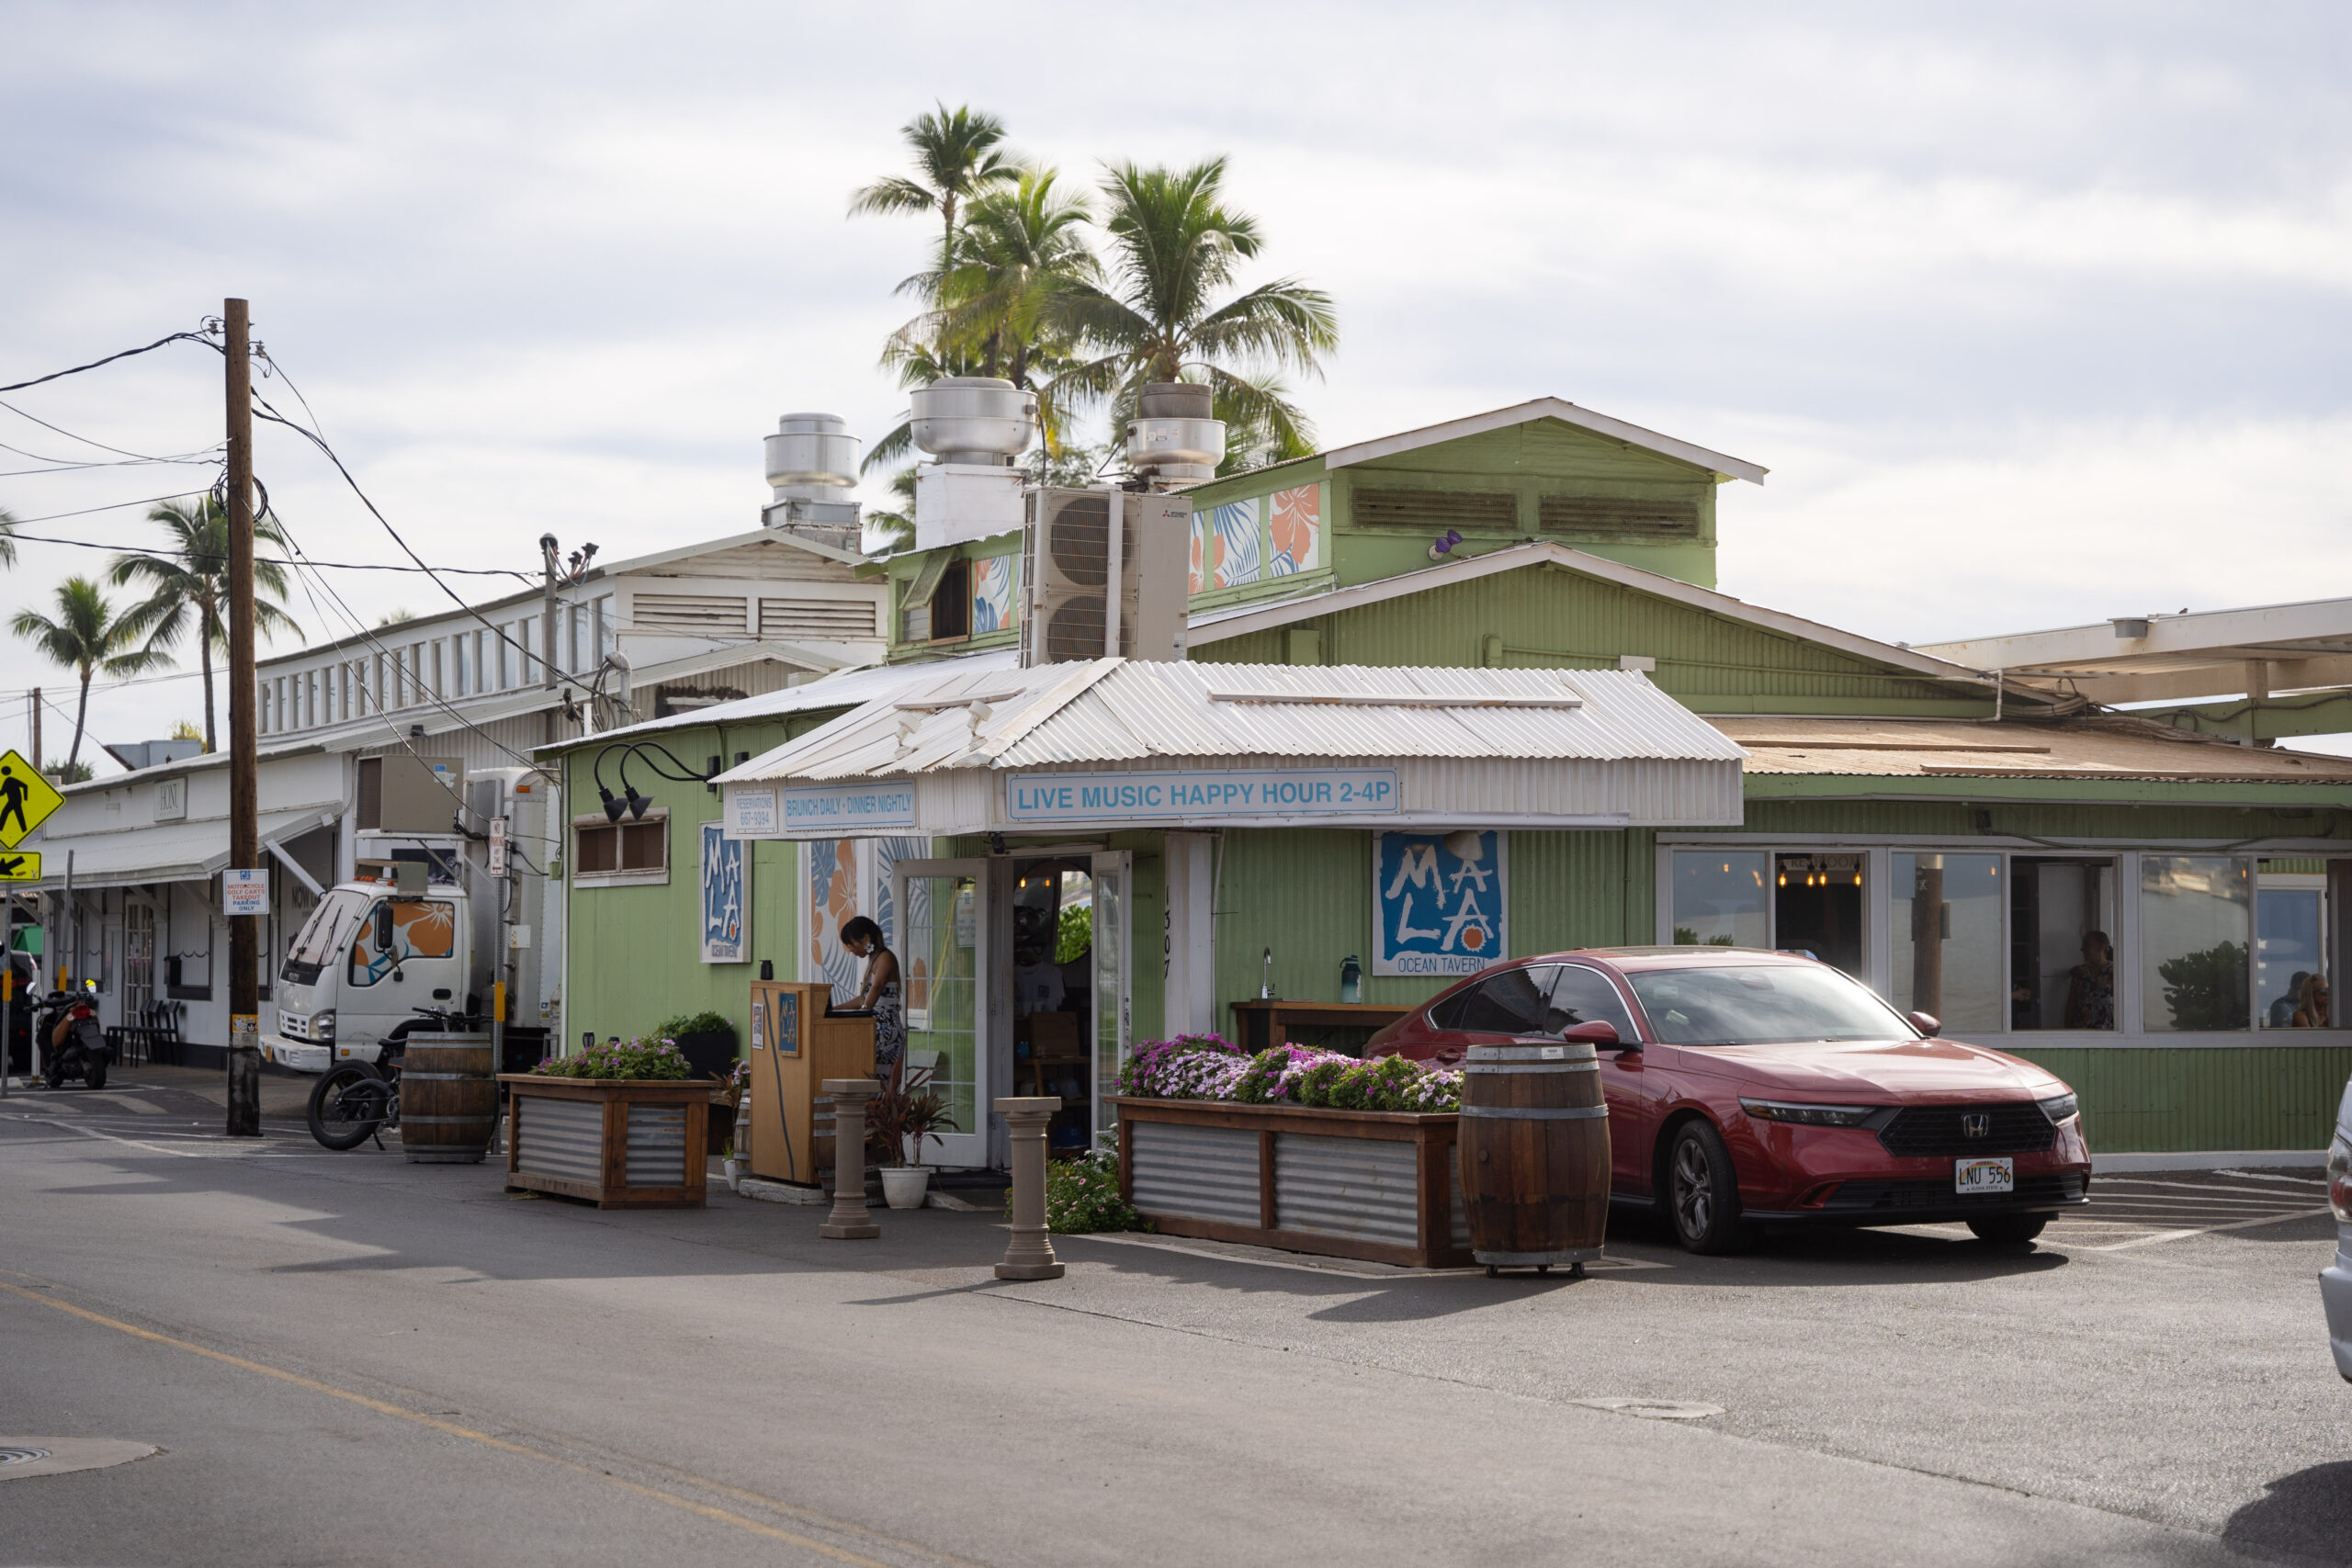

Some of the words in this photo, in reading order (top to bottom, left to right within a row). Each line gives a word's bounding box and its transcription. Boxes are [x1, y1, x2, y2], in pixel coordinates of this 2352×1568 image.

[736, 796, 772, 809] RESERVATIONS
[1018, 787, 1073, 809] LIVE
[1081, 785, 1161, 808] MUSIC
[1170, 784, 1254, 806] HAPPY
[1262, 782, 1331, 804] HOUR
[1340, 781, 1390, 802] 2-4P
[786, 798, 818, 817] BRUNCH
[820, 797, 841, 816] DAILY
[847, 795, 876, 815] DINNER
[877, 793, 911, 813] NIGHTLY
[741, 812, 769, 826] 667-9394
[1397, 957, 1437, 973] OCEAN
[1441, 957, 1485, 973] TAVERN
[1959, 1167, 1981, 1186] LNU
[1989, 1166, 2011, 1184] 556
